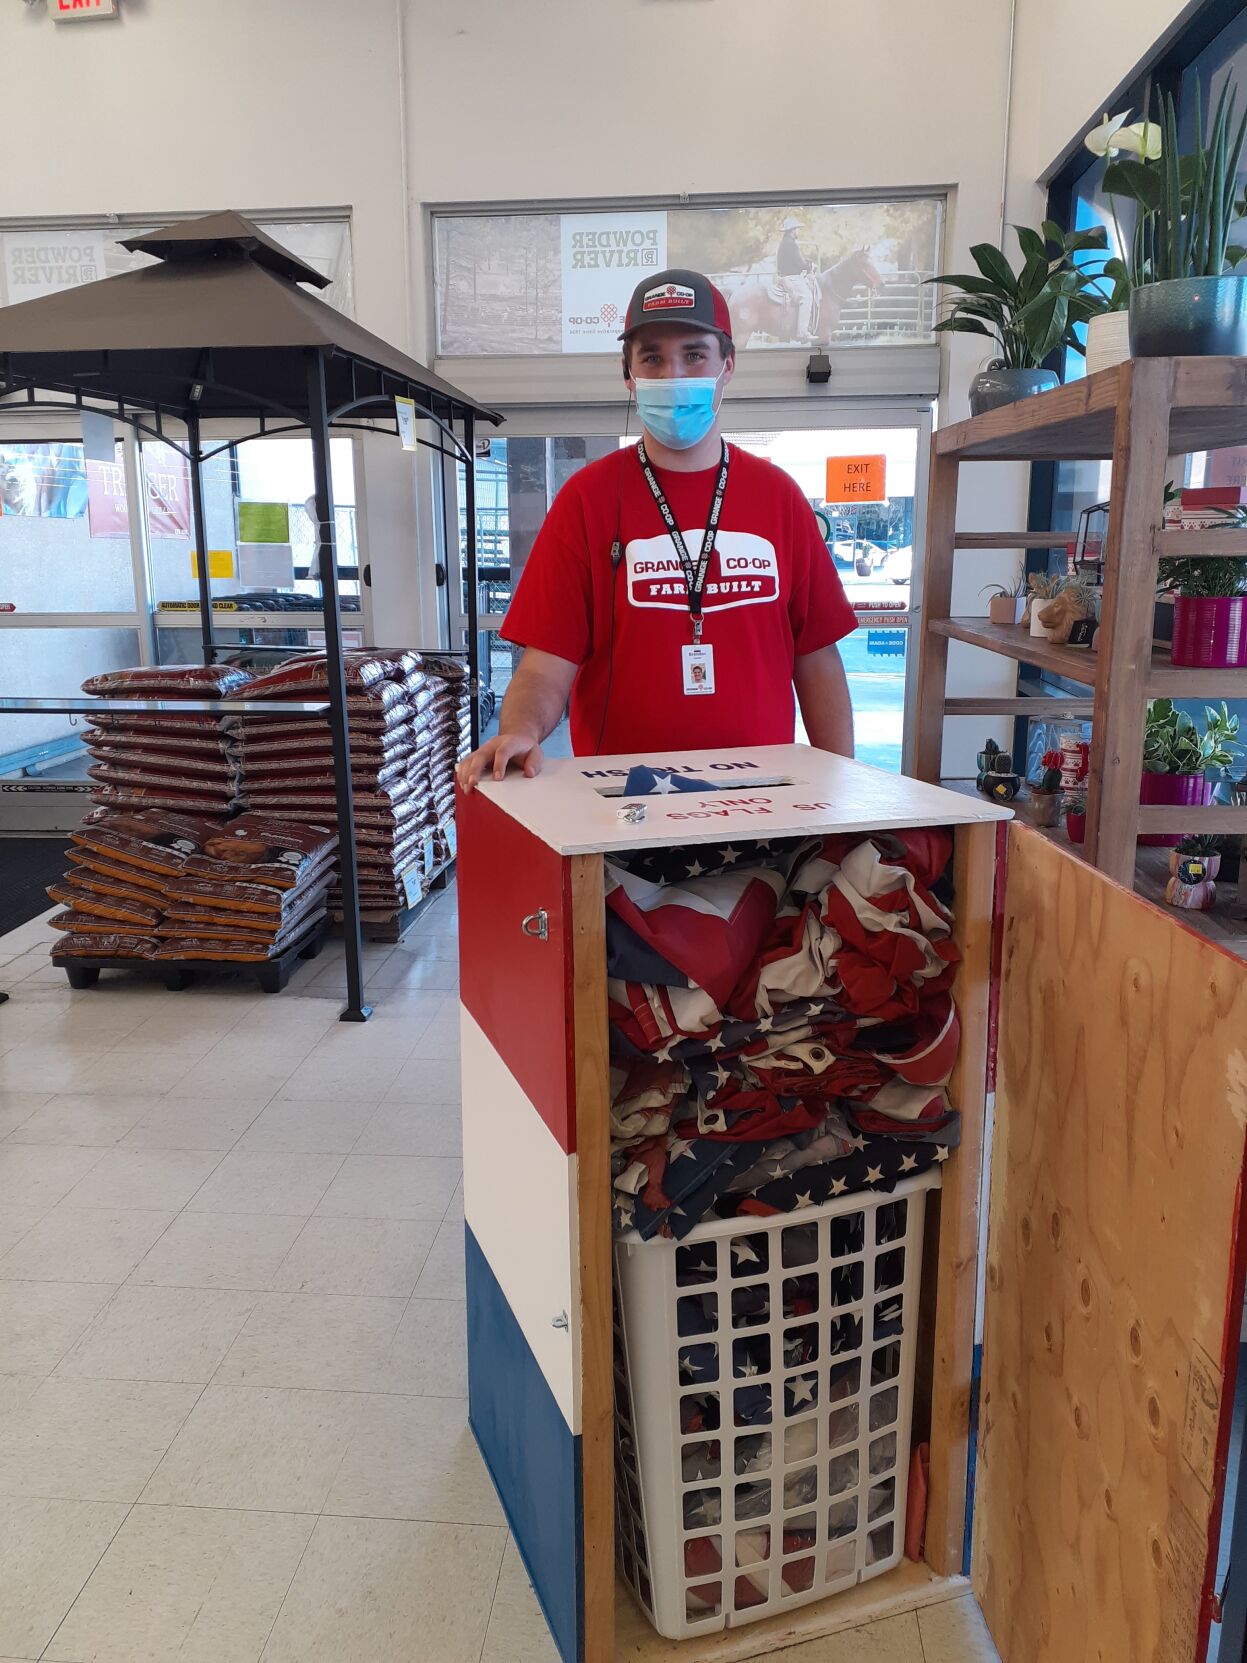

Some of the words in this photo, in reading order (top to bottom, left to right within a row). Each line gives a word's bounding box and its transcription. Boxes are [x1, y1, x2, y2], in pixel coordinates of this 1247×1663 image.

[847, 463, 870, 474] EXIT
[644, 467, 662, 498] GRANGE
[843, 482, 872, 493] HERE
[710, 496, 723, 525] GRANGE
[671, 530, 689, 564] GRANGE
[694, 560, 708, 592] GRANGE
[649, 583, 690, 596] FAR
[706, 580, 762, 595] BUILT
[580, 765, 703, 778] TRSH
[709, 761, 760, 771] NO
[699, 797, 772, 808] ONLY
[792, 801, 834, 811] US
[666, 807, 773, 820] FLAGS
